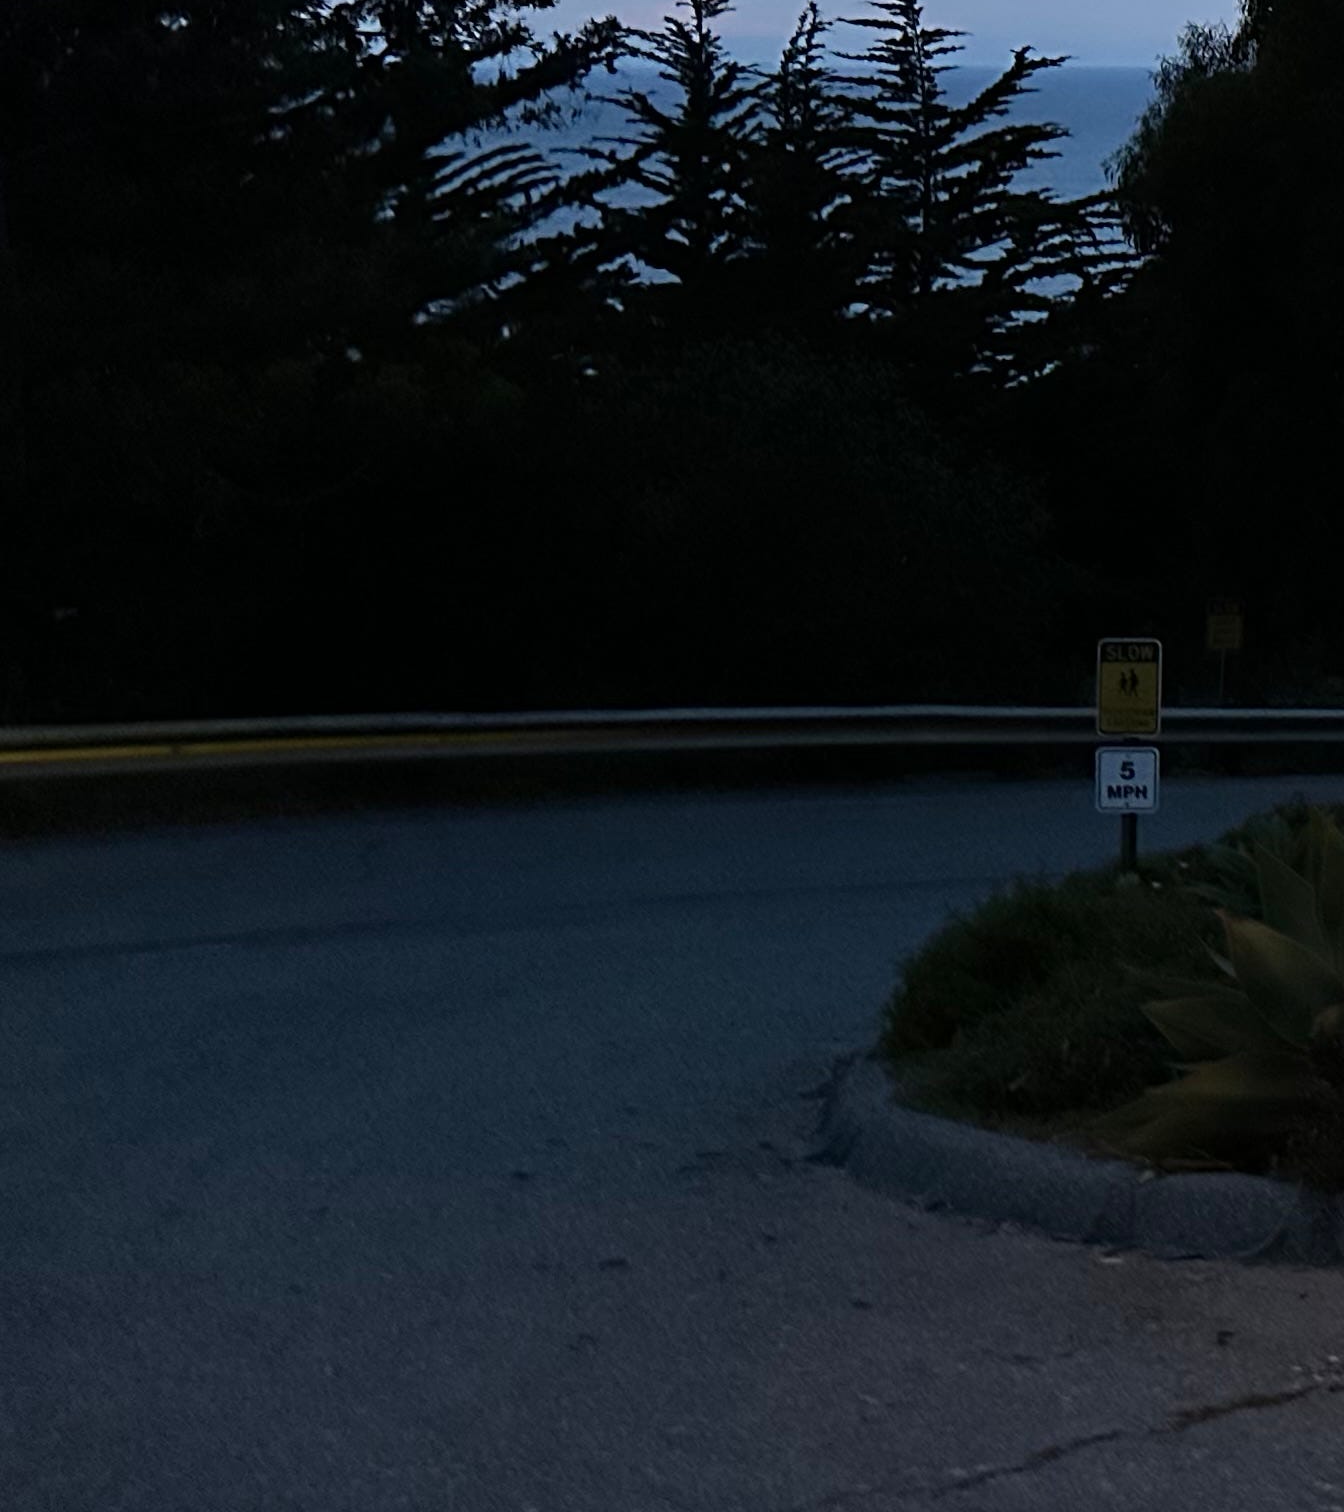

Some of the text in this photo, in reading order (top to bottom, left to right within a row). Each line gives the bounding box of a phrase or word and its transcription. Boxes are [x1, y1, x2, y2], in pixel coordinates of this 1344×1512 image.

[1105, 645, 1153, 661] SLOW
[1120, 761, 1136, 780] 5
[1107, 785, 1148, 799] MPH
